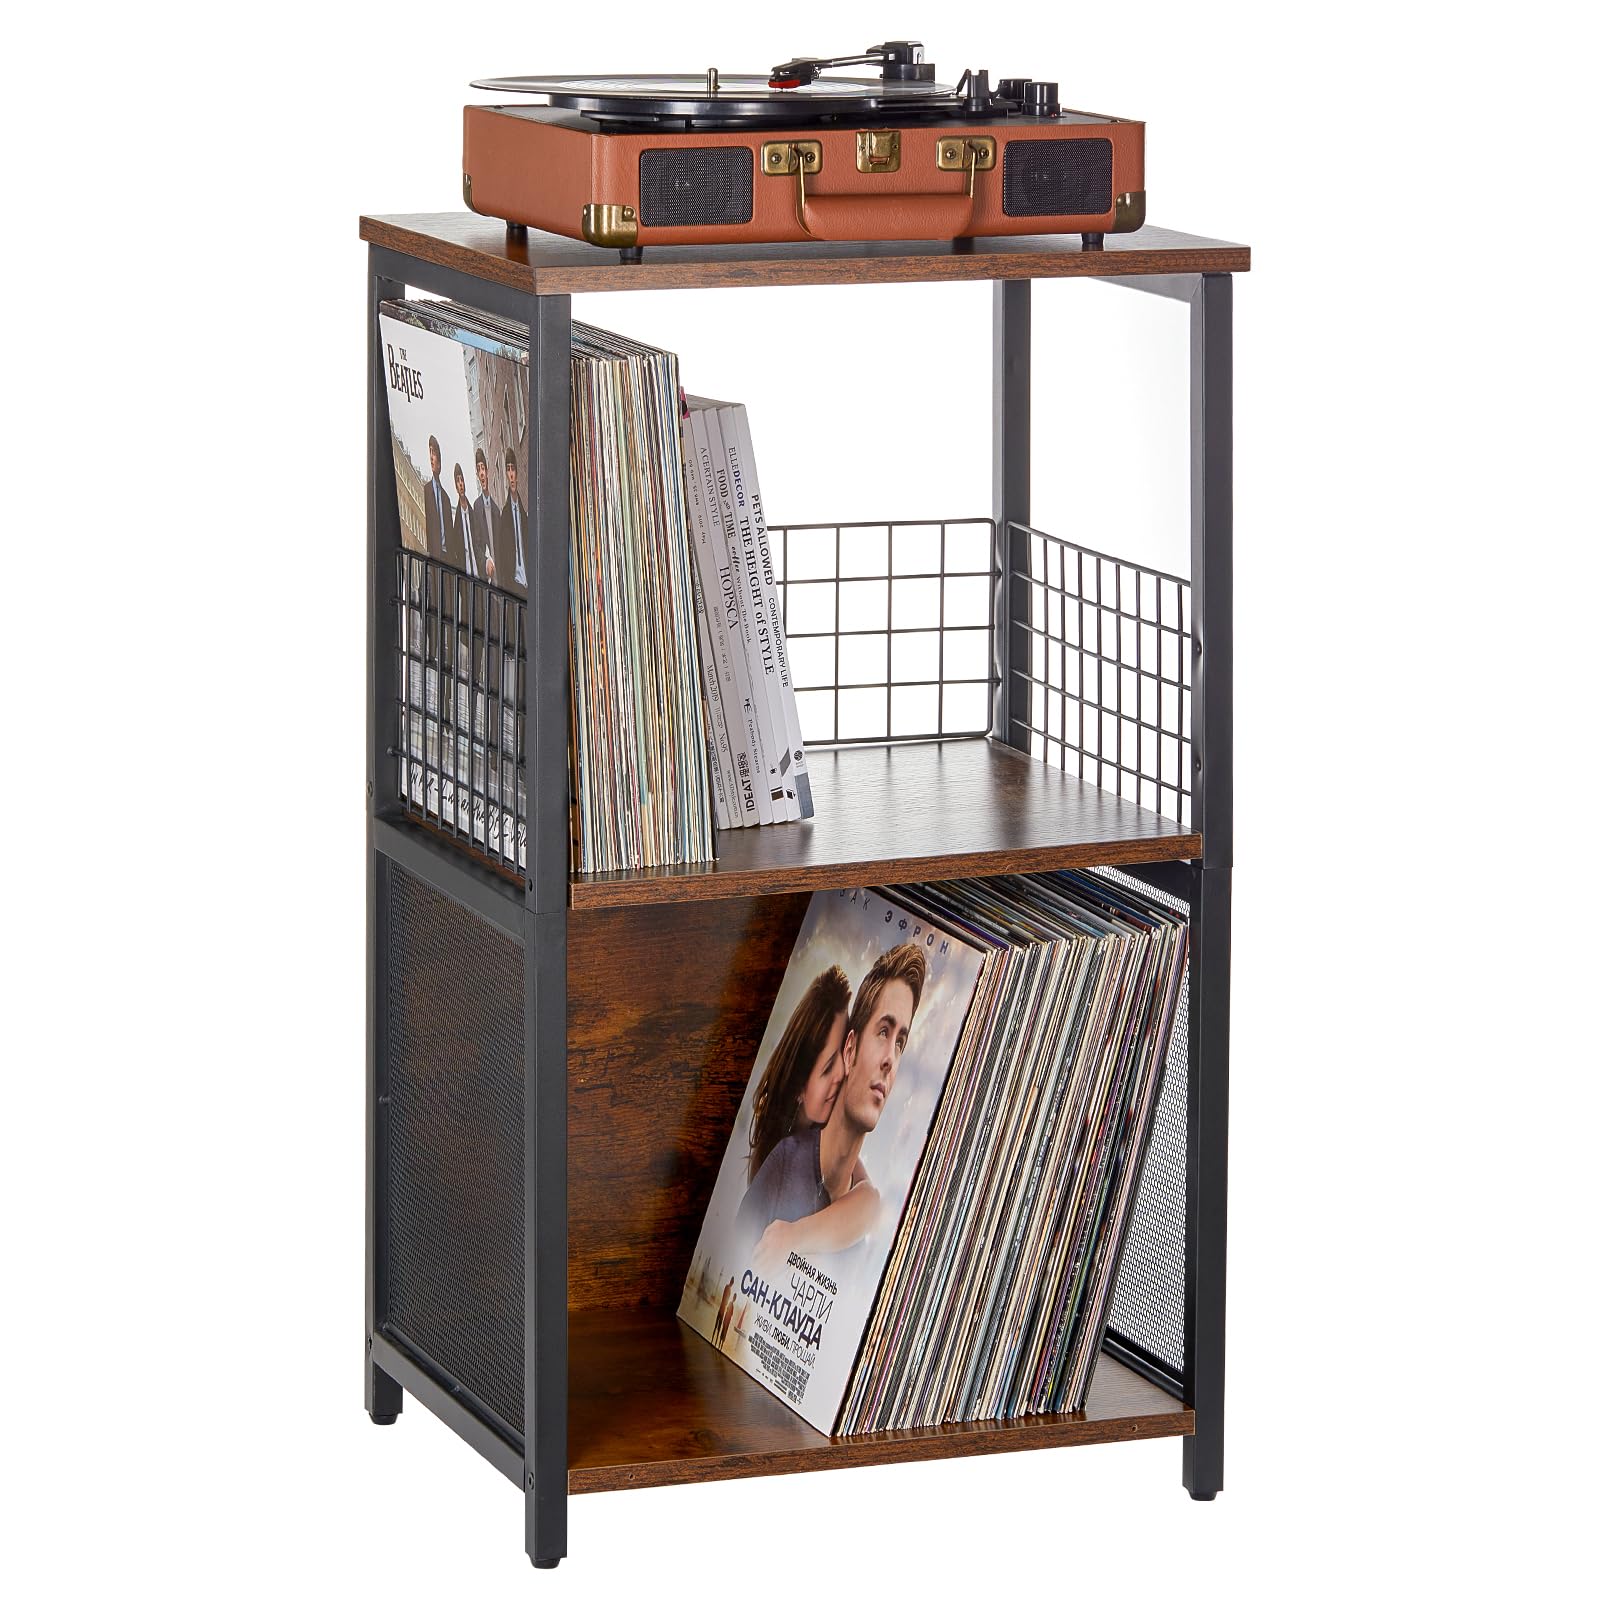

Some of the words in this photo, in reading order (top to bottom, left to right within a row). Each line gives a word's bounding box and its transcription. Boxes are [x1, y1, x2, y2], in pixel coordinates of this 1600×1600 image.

[387, 344, 424, 403] BEATLES
[399, 347, 407, 361] THE
[702, 454, 715, 495] CERTAIN
[708, 496, 721, 527] STYLE
[717, 469, 729, 498] FOOD
[725, 511, 737, 539] TIME
[751, 494, 763, 524] PETS
[740, 516, 753, 548] THE
[745, 550, 763, 608] HEIGHT
[756, 527, 773, 586] ALLOWED
[719, 566, 739, 630] HOPSCA
[756, 611, 766, 626] of
[758, 628, 775, 675] STYLE
[768, 597, 786, 668] CONTEMPORARY
[780, 669, 789, 688] LIFE
[741, 779, 755, 812] IDEAT
[884, 910, 949, 954] ЭФРОН
[786, 1251, 816, 1280] ДВОЙНАЯ
[815, 1270, 838, 1296] ЖИЗНЬ
[740, 1269, 823, 1350] САН-КЛАУДА
[790, 1272, 834, 1324] ЧАРЛИ
